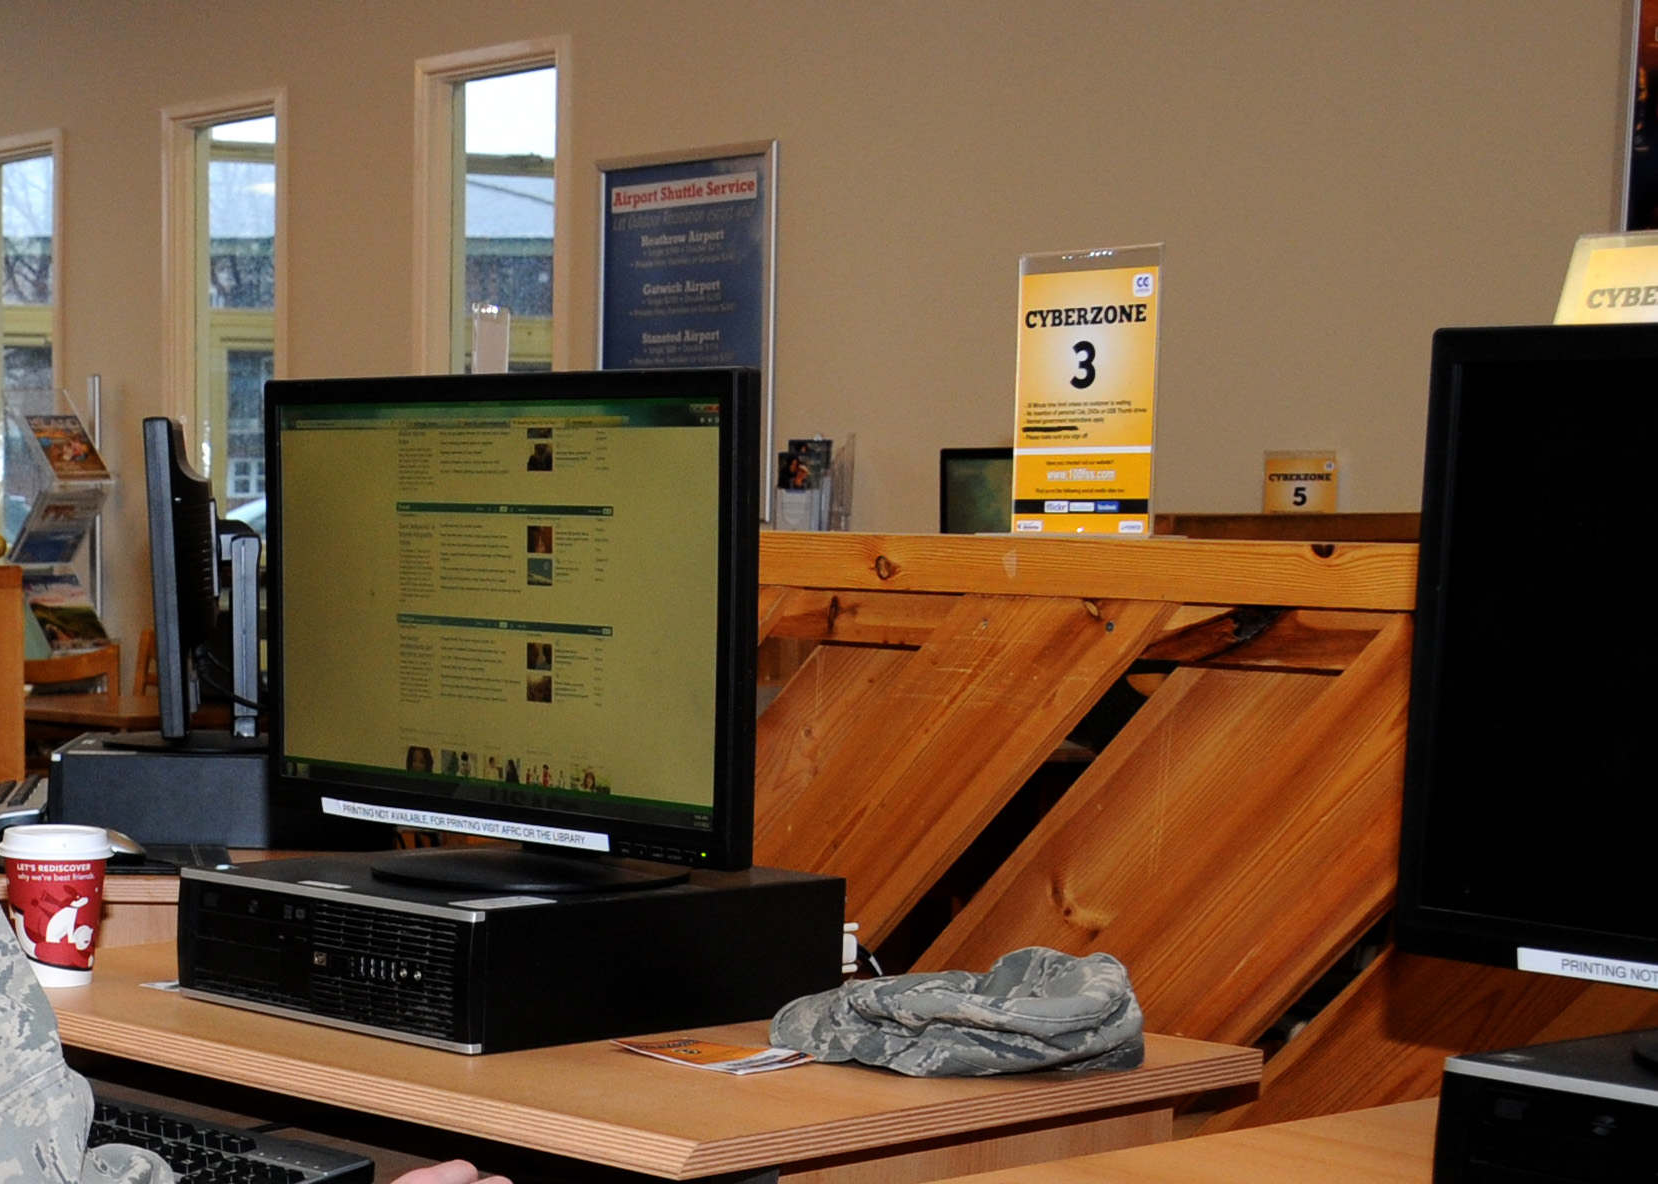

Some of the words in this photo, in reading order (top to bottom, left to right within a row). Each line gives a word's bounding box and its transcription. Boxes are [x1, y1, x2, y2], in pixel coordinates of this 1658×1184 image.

[613, 190, 658, 208] Airport
[660, 184, 703, 202] Shuttle
[707, 179, 755, 196] Service
[641, 232, 686, 248] Heathrow
[688, 229, 724, 246] Airport
[643, 282, 682, 296] Gatwick
[684, 279, 721, 295] Airport
[1586, 285, 1658, 309] CYBE
[1025, 303, 1147, 329] CYBERZONE
[683, 329, 720, 345] Airport
[1070, 340, 1096, 389] 3
[1268, 473, 1333, 482] CYBERZONE
[1046, 502, 1066, 511] flickr
[1292, 486, 1307, 507] 5
[342, 804, 375, 818] PRINTING
[375, 809, 389, 819] NOT
[430, 815, 445, 826] FOR
[446, 817, 481, 831] PRINTING
[481, 822, 499, 833] VISIT
[501, 825, 523, 836] AFRC
[523, 828, 535, 838] OR
[536, 829, 551, 840] THE
[552, 831, 586, 845] LIBRARY
[16, 863, 36, 872] LET'S
[37, 863, 91, 872] REDISCOVER
[17, 873, 30, 882] why
[31, 873, 52, 881] we're
[53, 873, 70, 881] best
[1561, 958, 1626, 979] PRINTING
[1630, 968, 1658, 983] NOT
